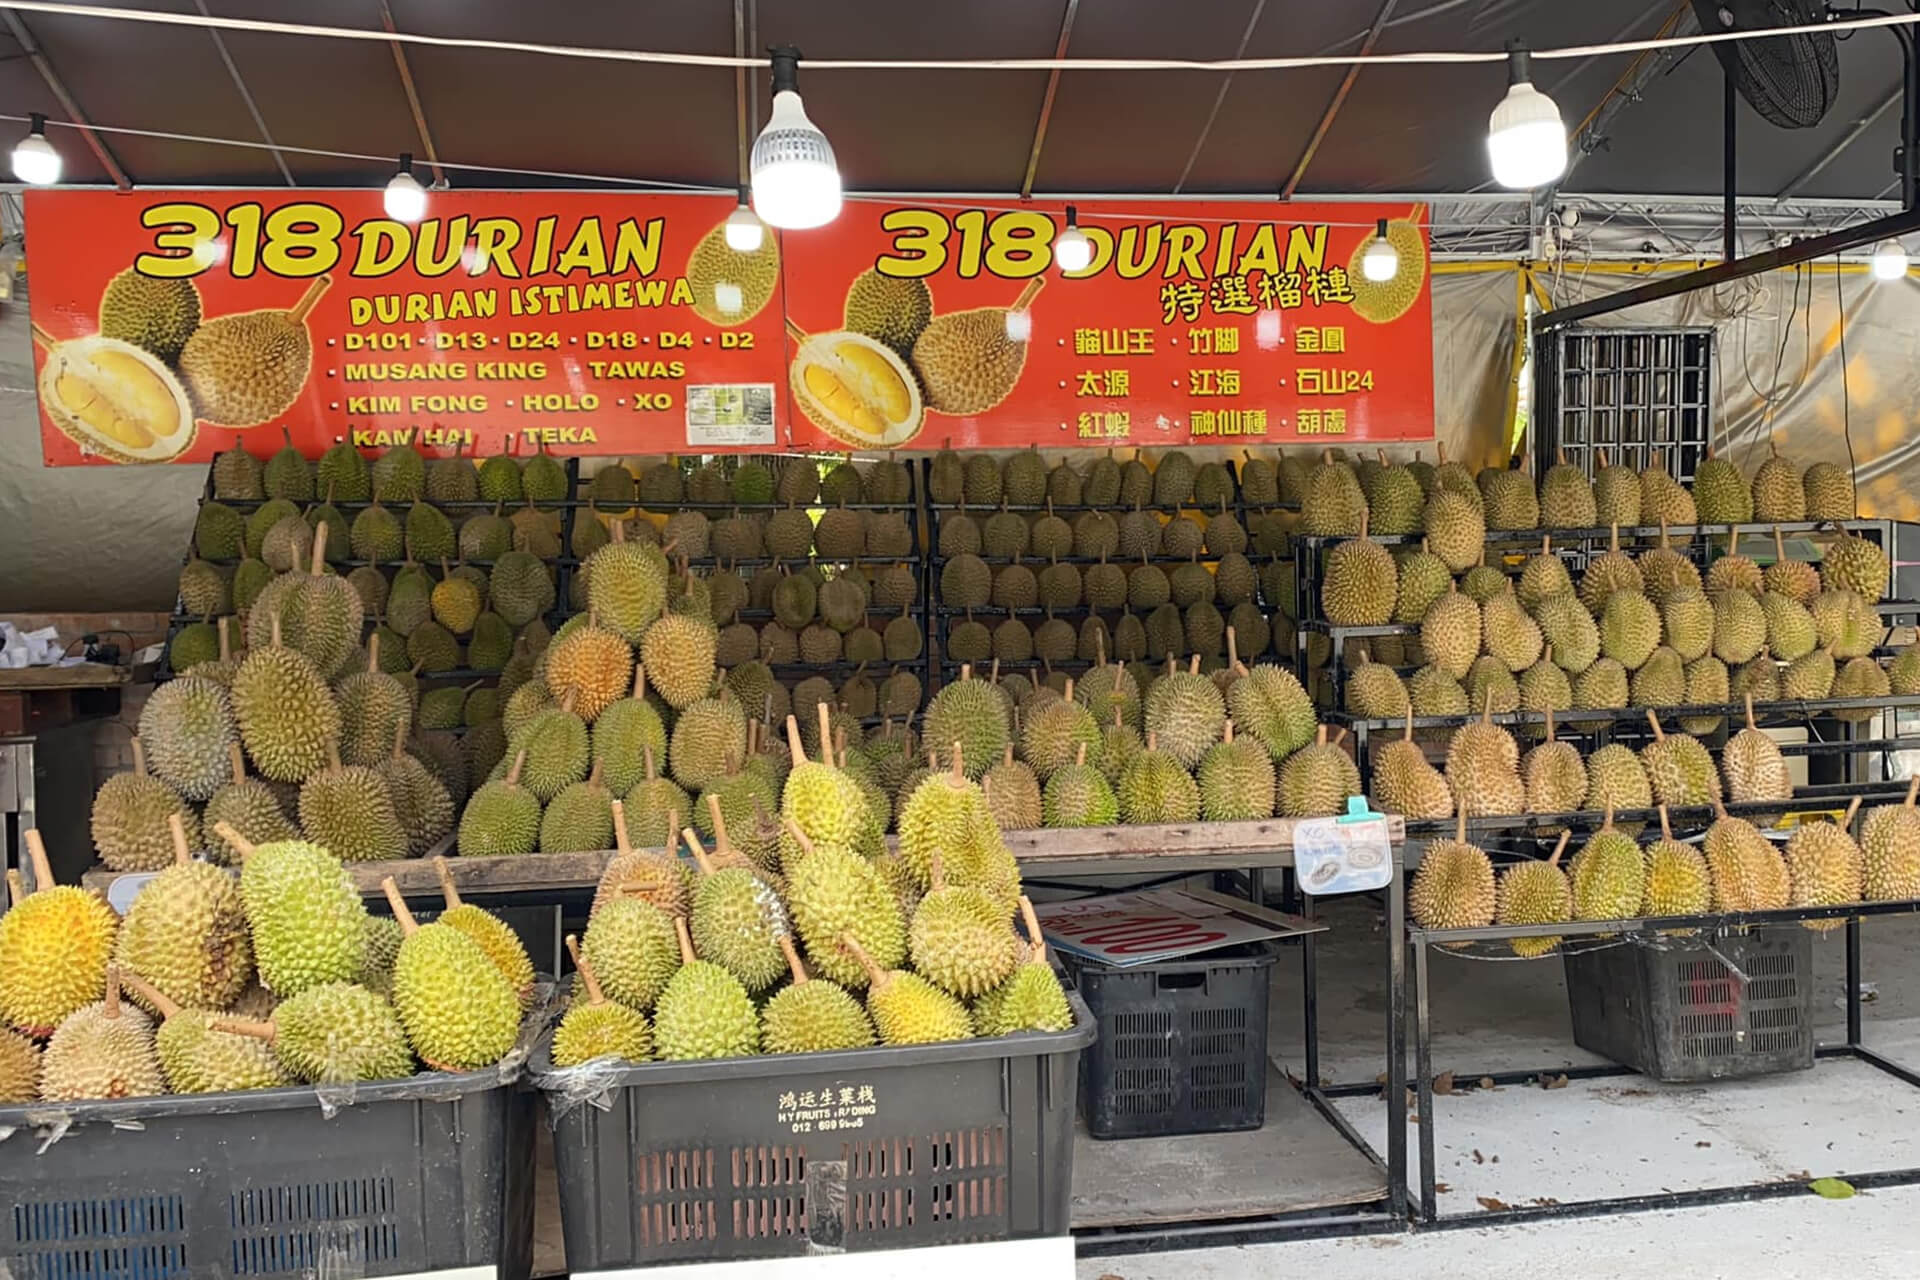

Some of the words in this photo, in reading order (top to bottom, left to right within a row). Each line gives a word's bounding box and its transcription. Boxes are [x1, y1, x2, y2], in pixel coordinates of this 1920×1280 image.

[135, 202, 343, 279] 318
[350, 214, 666, 279] DURIAN
[875, 210, 1055, 278] 318
[1060, 223, 1330, 279] DURIAN
[350, 289, 496, 327] DURIAN
[510, 278, 696, 317] ISTIMEWA
[1160, 266, 1355, 324] 特選榴槤
[345, 333, 411, 349] D101
[435, 332, 487, 349] D13
[509, 332, 560, 348] D24
[587, 332, 637, 348] D18
[660, 332, 693, 348] D4
[720, 332, 754, 348] D2
[1075, 328, 1154, 354] 貓山王
[346, 363, 467, 380] MUSANG
[477, 362, 547, 379] KING
[589, 361, 686, 378] TAWAS
[1076, 370, 1129, 396] 太源
[1189, 370, 1240, 395] 江海
[1297, 369, 1374, 394] 石山24
[348, 396, 400, 413] KIM
[410, 395, 488, 412] FONG
[523, 394, 599, 411] HOLO
[634, 393, 673, 410] XO
[424, 428, 472, 446] HAI
[523, 427, 597, 443] TEKA
